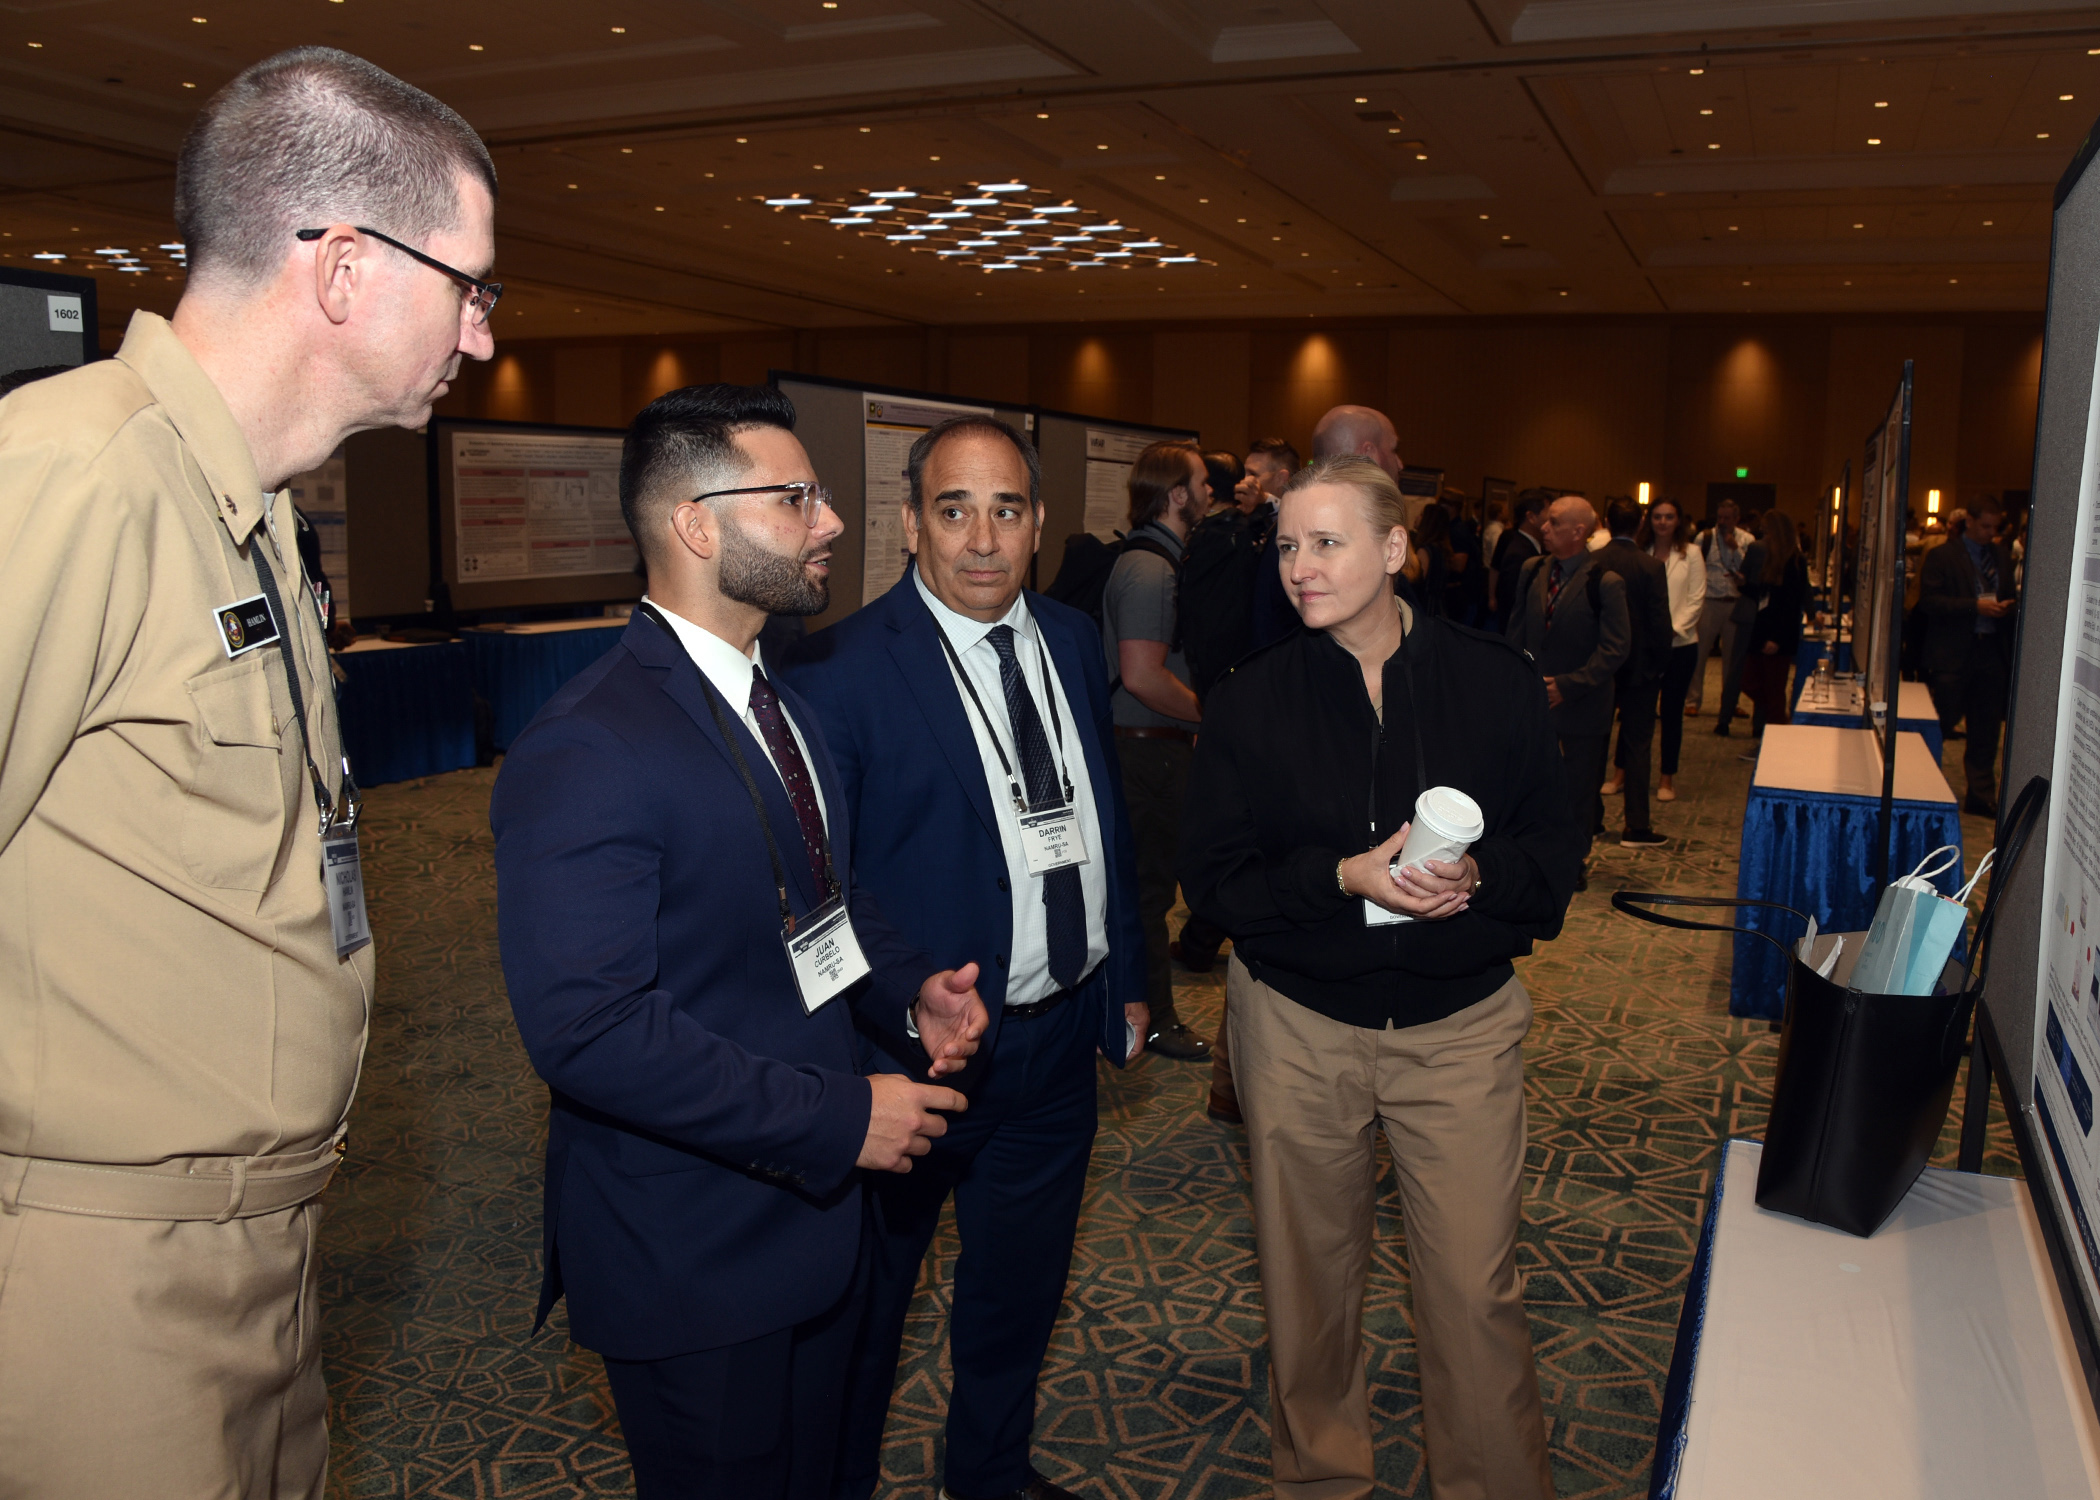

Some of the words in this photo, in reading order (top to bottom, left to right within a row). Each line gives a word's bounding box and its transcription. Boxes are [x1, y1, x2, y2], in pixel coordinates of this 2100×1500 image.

[54, 308, 80, 320] 1602
[1039, 824, 1067, 838] DARRIN
[1047, 834, 1062, 843] FRYE
[1044, 841, 1069, 852] NAMRU-SA
[815, 937, 835, 958] JUAN
[814, 946, 841, 968] CURBELO
[817, 956, 844, 978] NAMRU-SA
